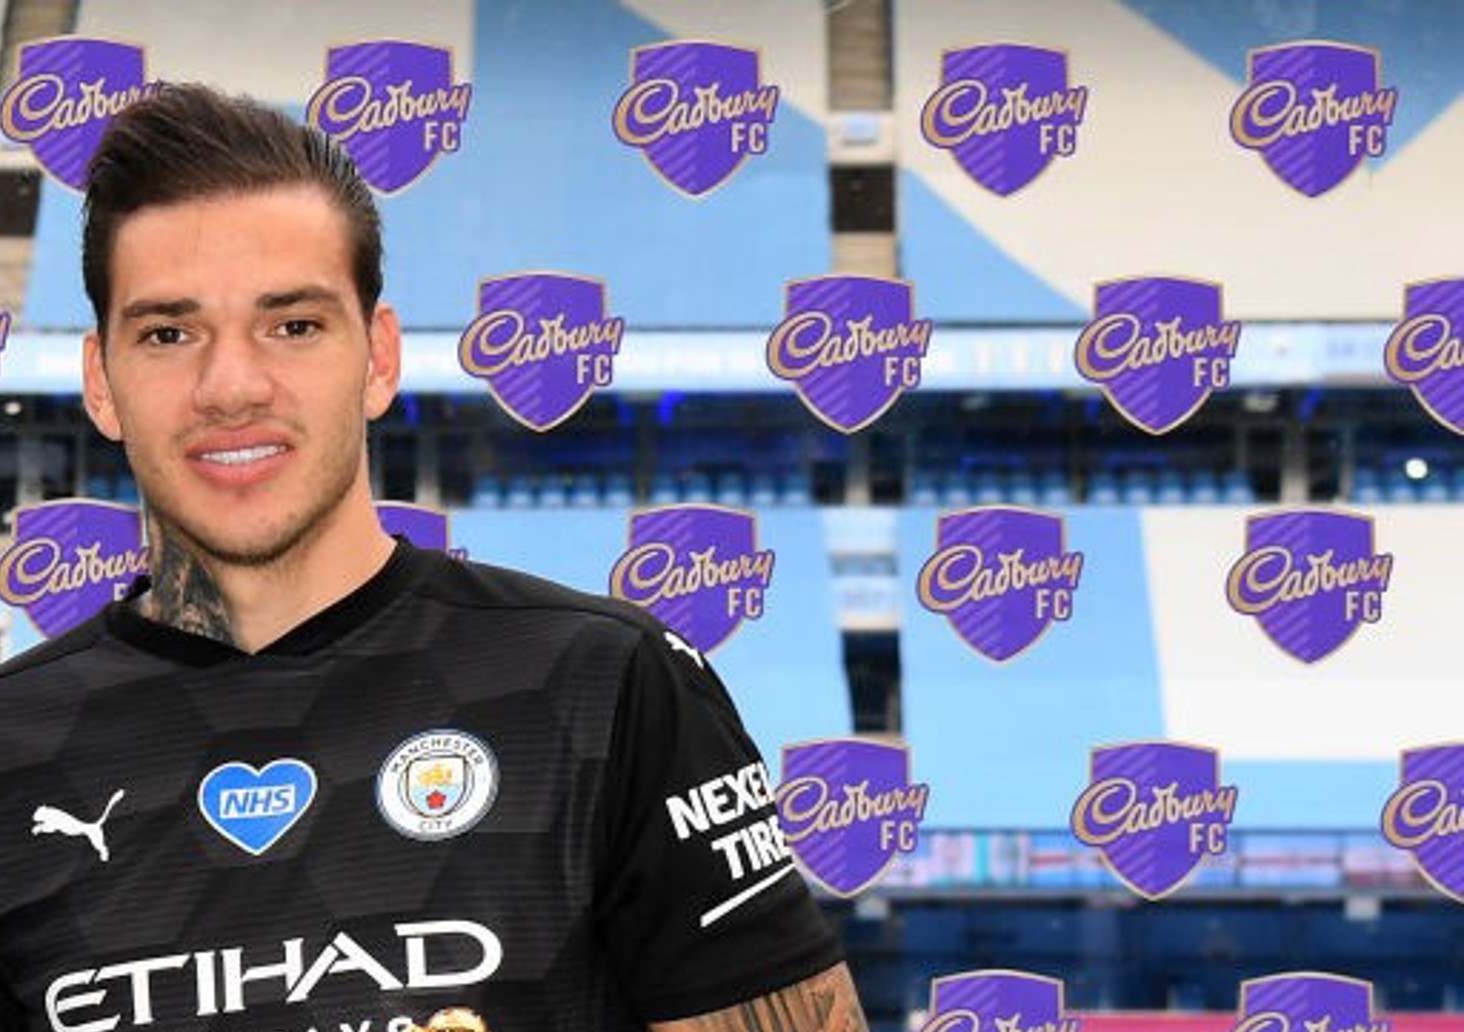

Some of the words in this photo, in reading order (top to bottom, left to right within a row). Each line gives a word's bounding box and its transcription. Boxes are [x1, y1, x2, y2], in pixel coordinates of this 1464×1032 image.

[308, 75, 469, 142] Cadbury
[615, 77, 776, 144] Cadbury
[923, 79, 1084, 146] Cadbury
[1233, 80, 1394, 147] Cadbury
[424, 120, 458, 151] FC
[731, 122, 765, 153] FC
[1039, 124, 1073, 155] FC
[1349, 125, 1383, 156] FC
[460, 309, 621, 376] Cadbury
[768, 311, 929, 378] Cadbury
[1077, 312, 1238, 379] Cadbury
[576, 354, 610, 385] FC
[884, 356, 918, 387] FC
[1193, 357, 1227, 388] FC
[611, 542, 772, 609] Cadbury
[919, 544, 1080, 611] Cadbury
[1229, 545, 1390, 612] Cadbury
[727, 587, 761, 618] FC
[1035, 589, 1069, 620] FC
[1345, 590, 1379, 621] FC
[390, 738, 484, 773] MANCHESTER
[222, 789, 291, 815] NHS
[775, 775, 926, 842] Cadbury
[1074, 777, 1235, 844] Cadbury
[881, 820, 915, 851] FC
[1190, 822, 1224, 853] FC
